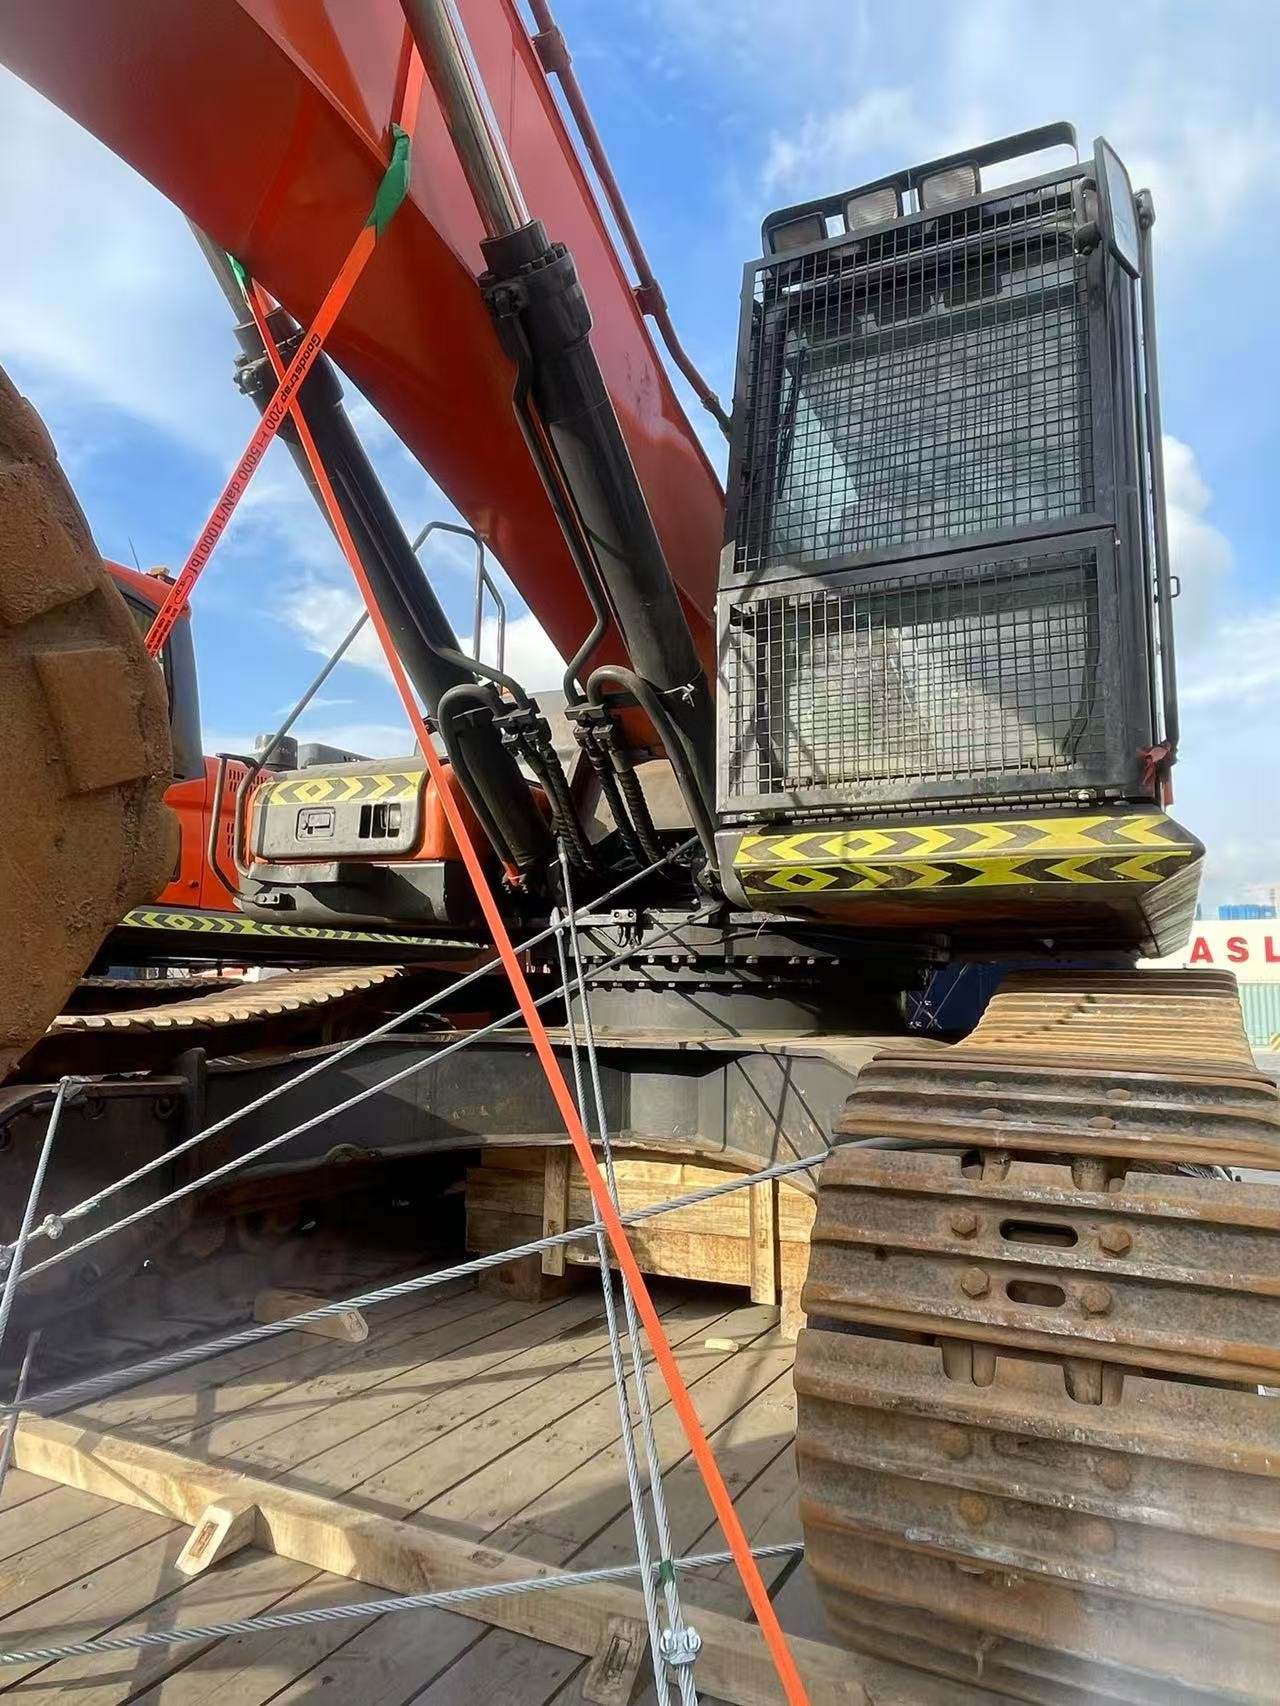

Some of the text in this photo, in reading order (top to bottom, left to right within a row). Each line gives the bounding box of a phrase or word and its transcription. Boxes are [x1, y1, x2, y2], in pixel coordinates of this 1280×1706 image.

[281, 333, 321, 401] Goodstrap
[265, 403, 284, 430] 200
[239, 446, 262, 481] 5000
